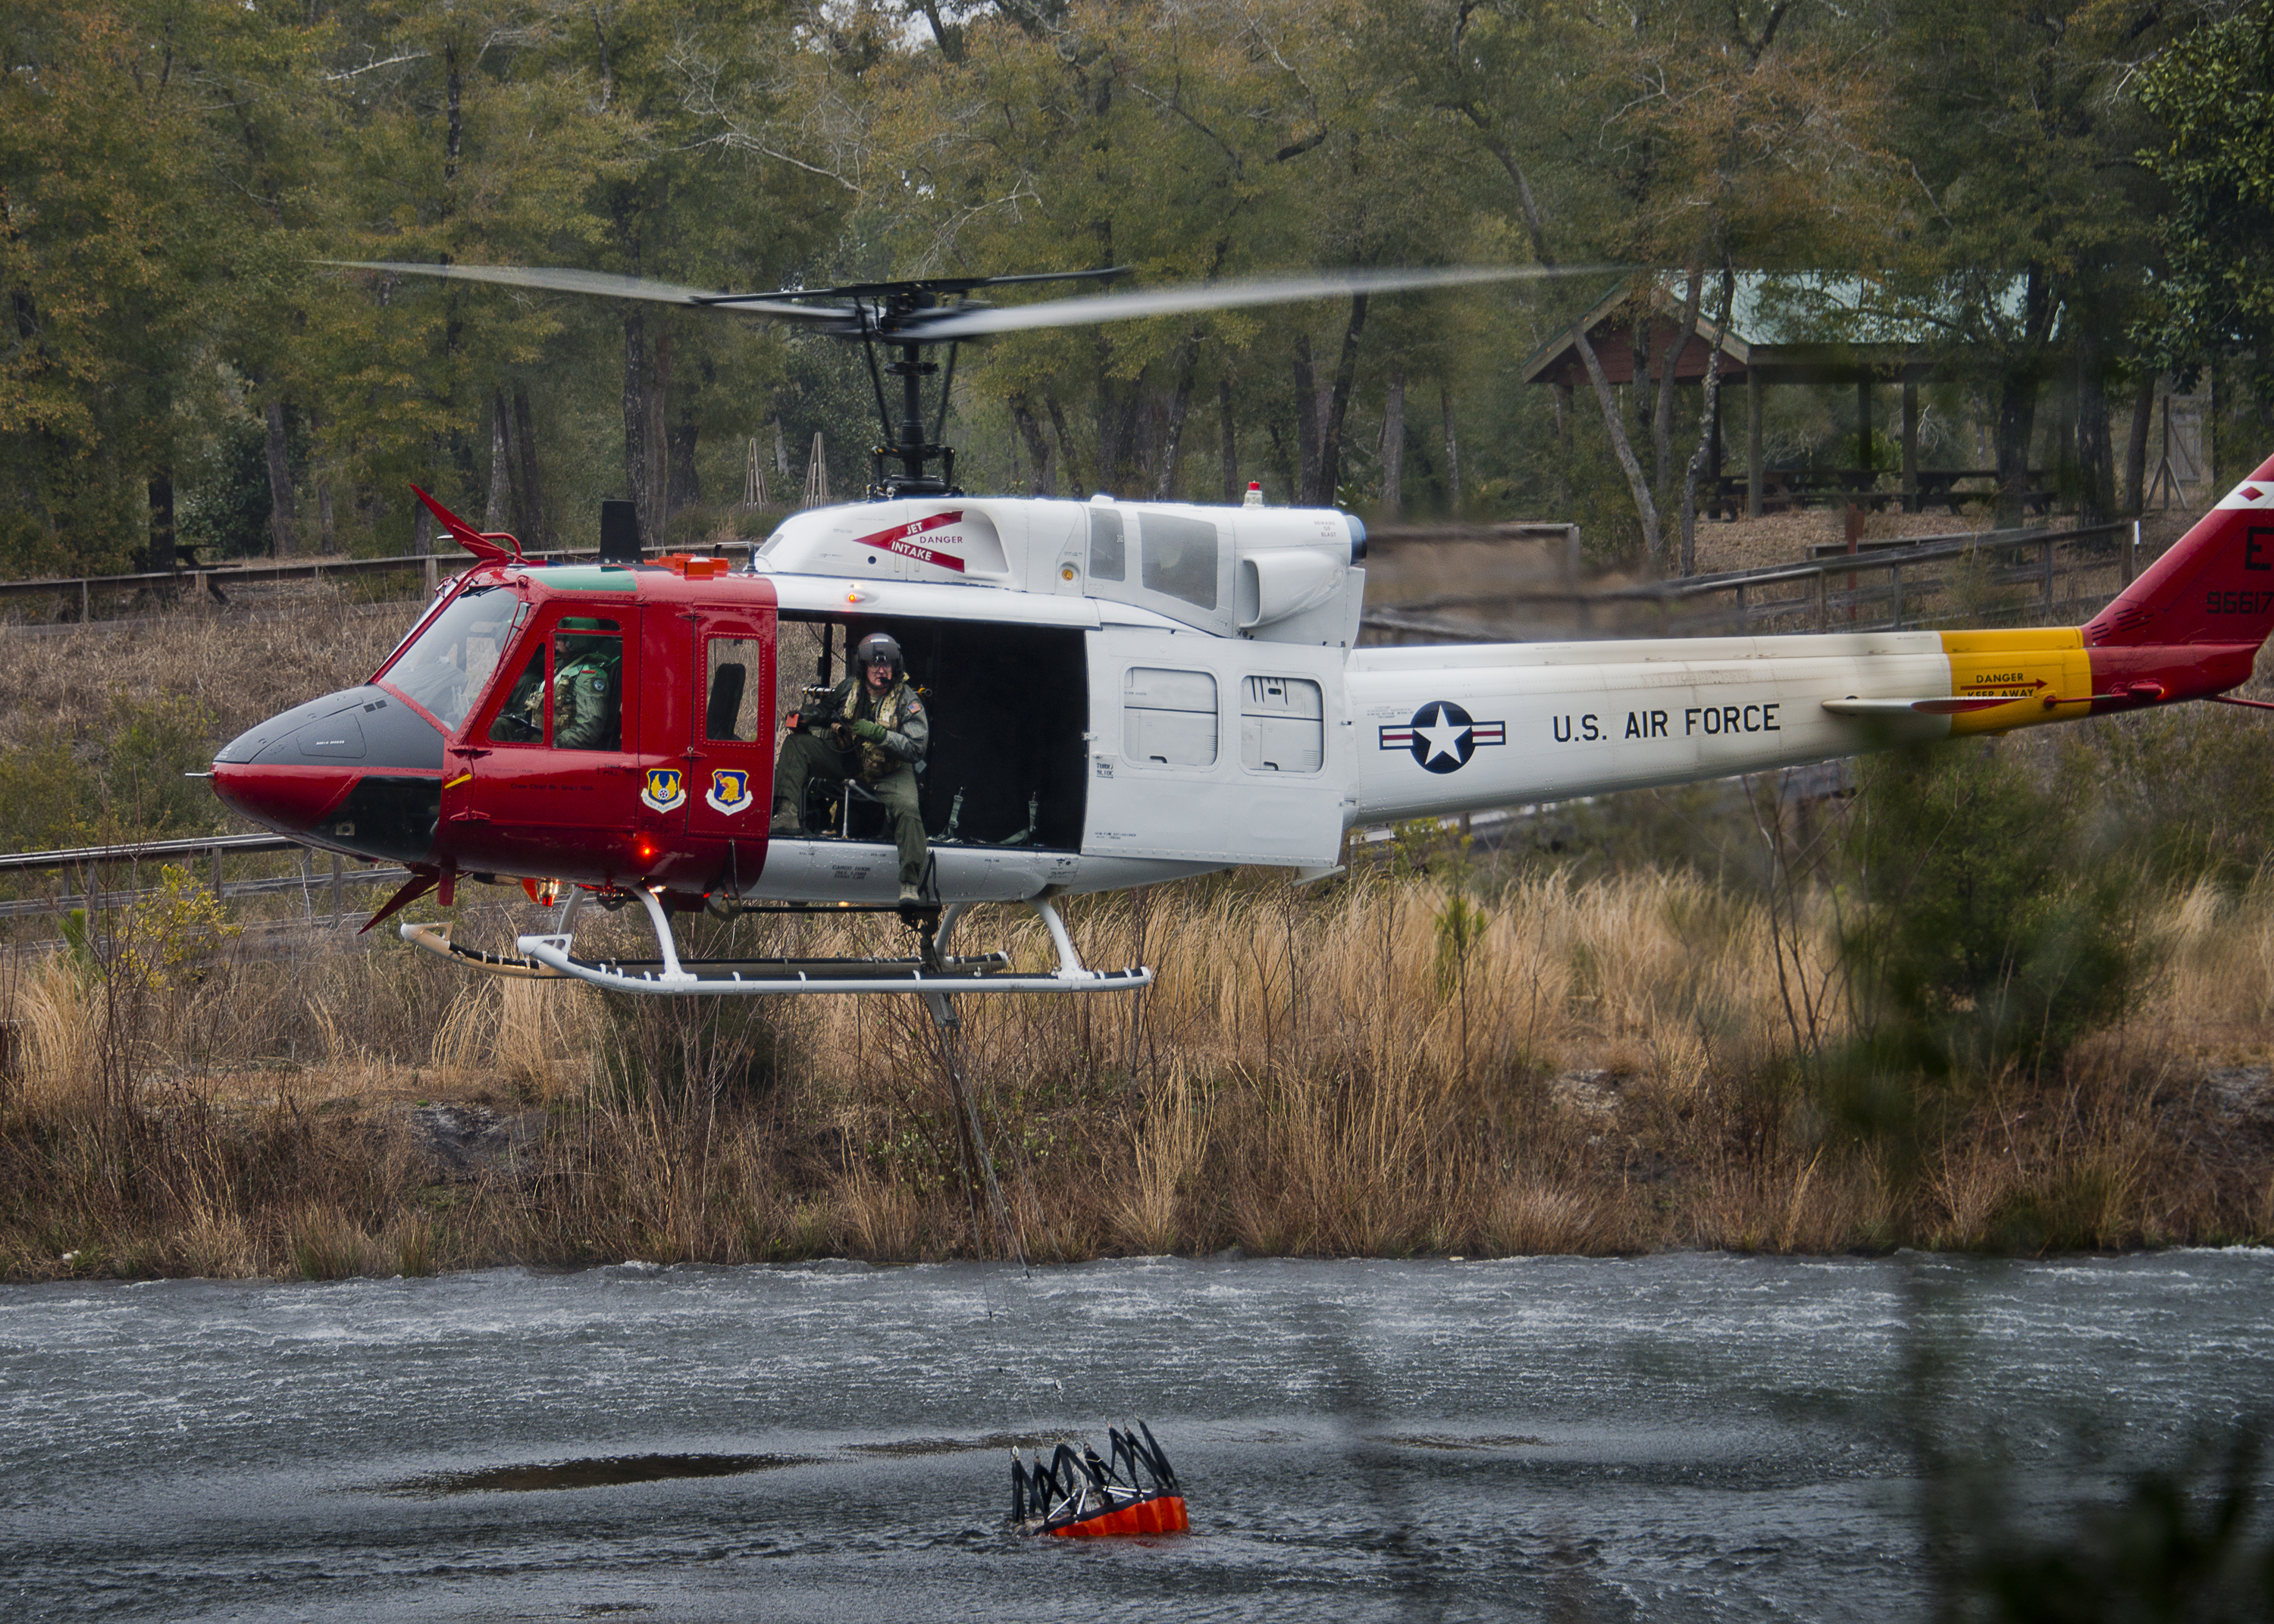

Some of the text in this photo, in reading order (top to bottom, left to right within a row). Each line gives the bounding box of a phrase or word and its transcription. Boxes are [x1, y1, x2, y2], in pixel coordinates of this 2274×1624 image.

[906, 521, 922, 535] JET
[919, 536, 963, 544] DANGER
[891, 541, 932, 562] INTAKE
[1976, 673, 2024, 684] DANGER
[2001, 688, 2034, 696] AWAY
[1553, 703, 1781, 743] U.S. AIR FORCE
